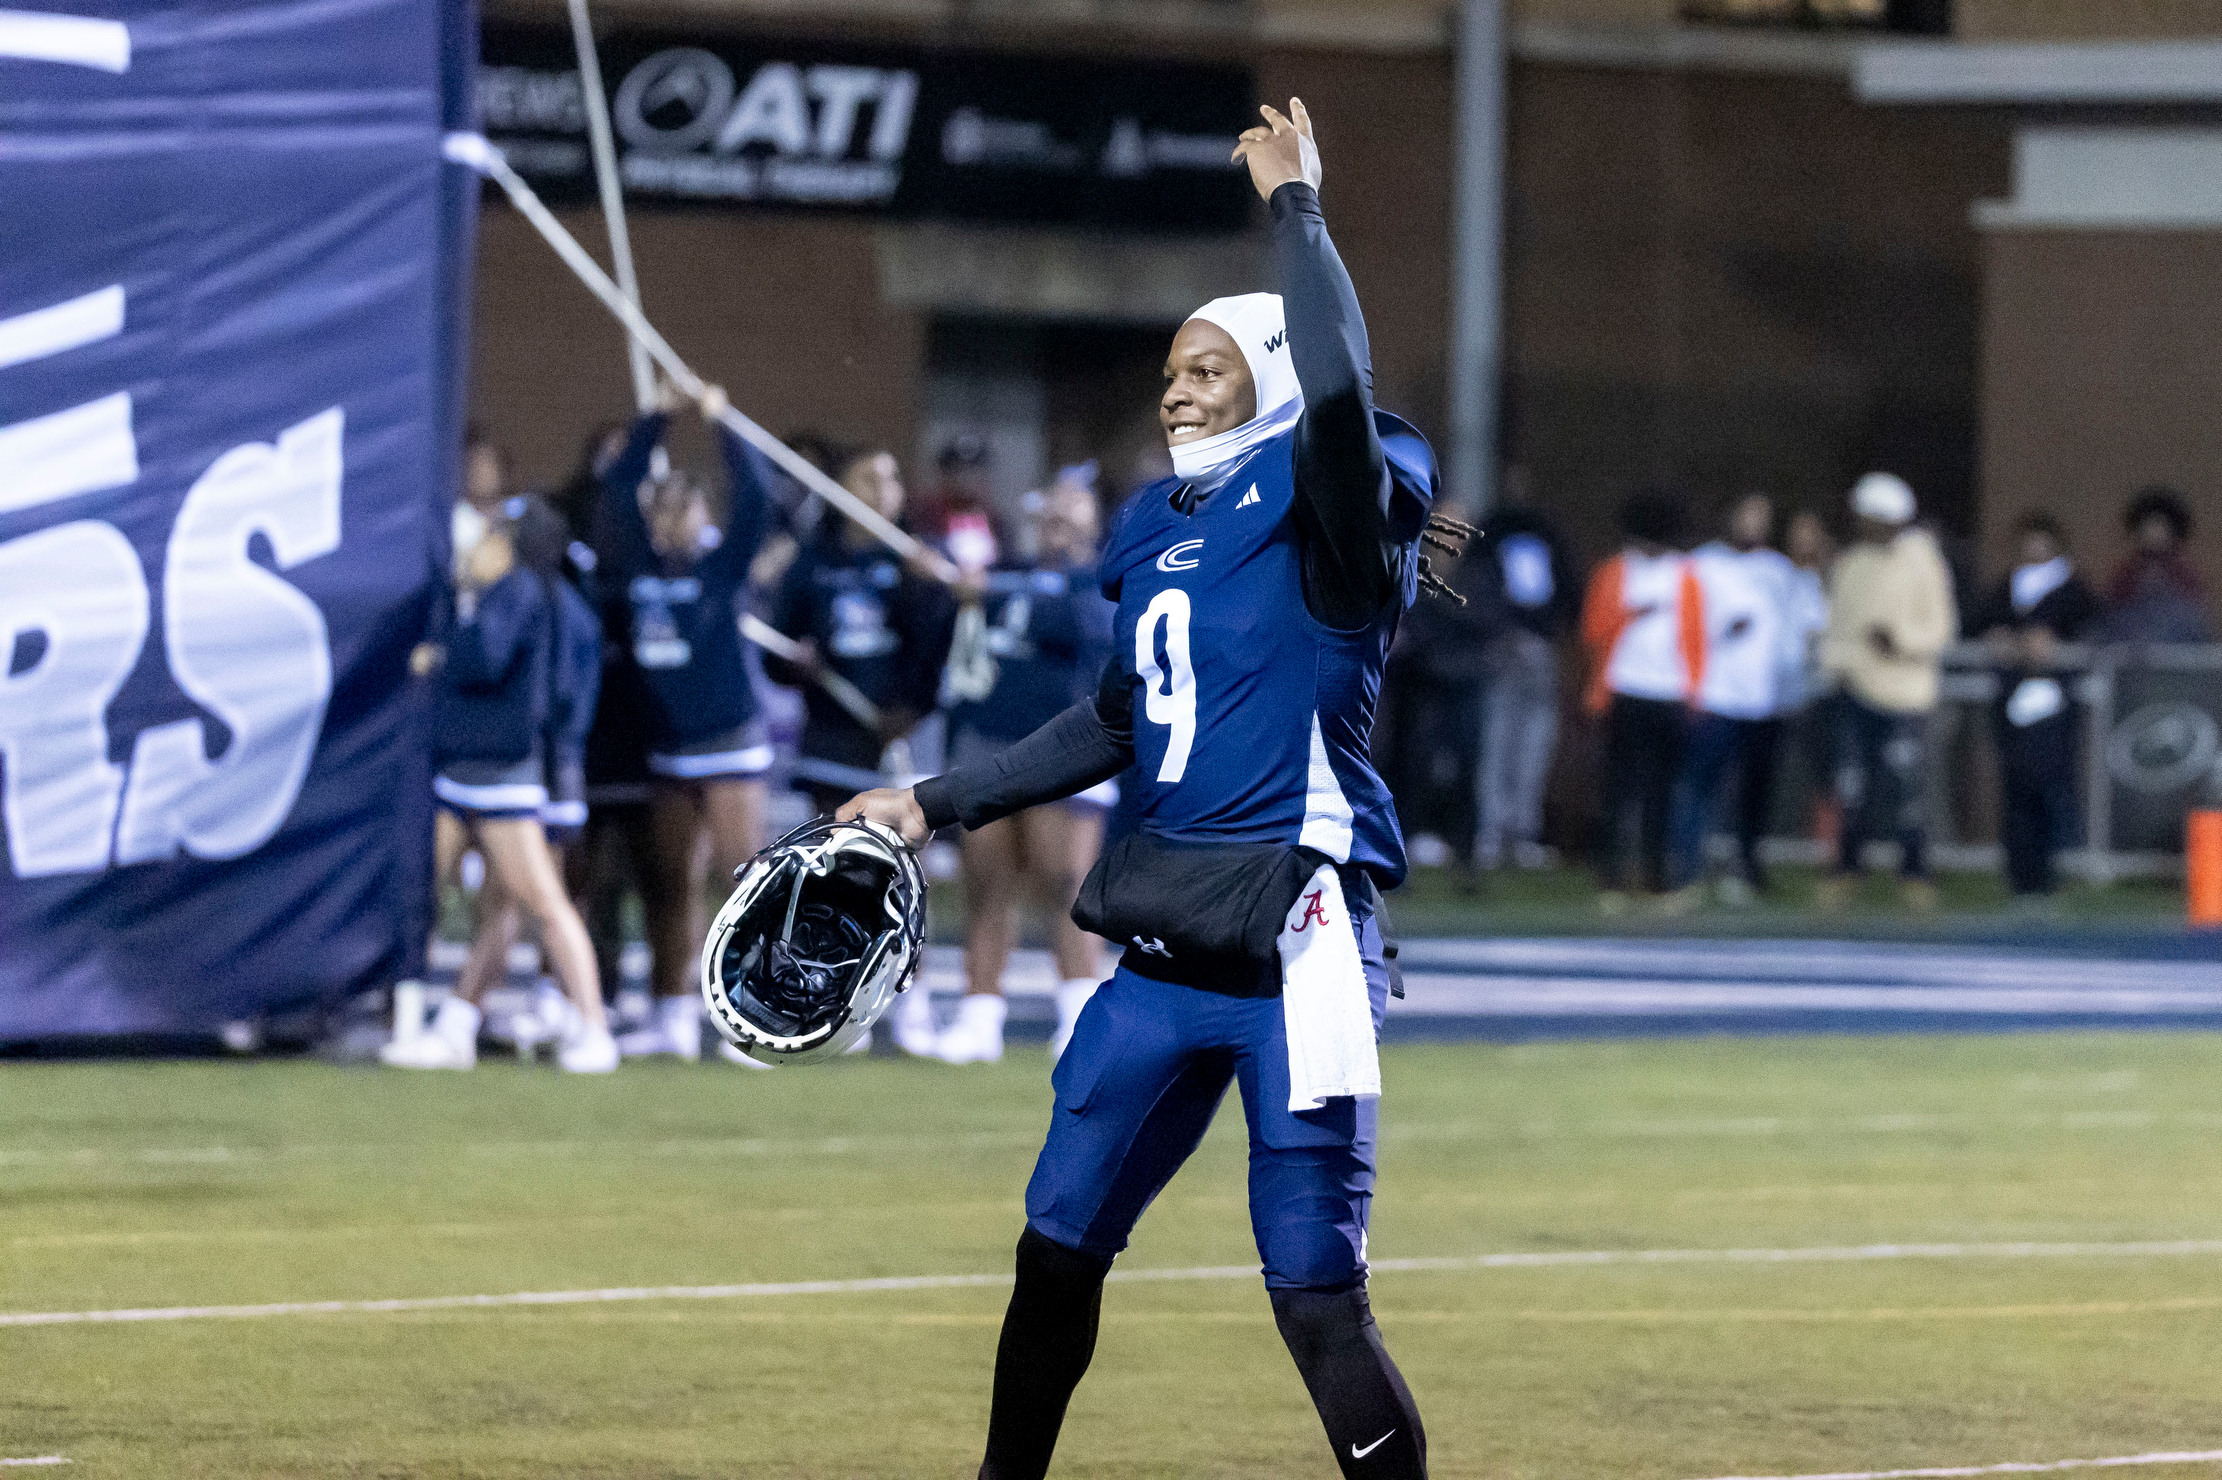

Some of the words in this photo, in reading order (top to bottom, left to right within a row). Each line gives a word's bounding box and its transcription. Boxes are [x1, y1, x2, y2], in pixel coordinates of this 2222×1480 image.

[719, 62, 919, 156] ATI
[1136, 588, 1197, 783] 9
[1291, 889, 1330, 932] A
